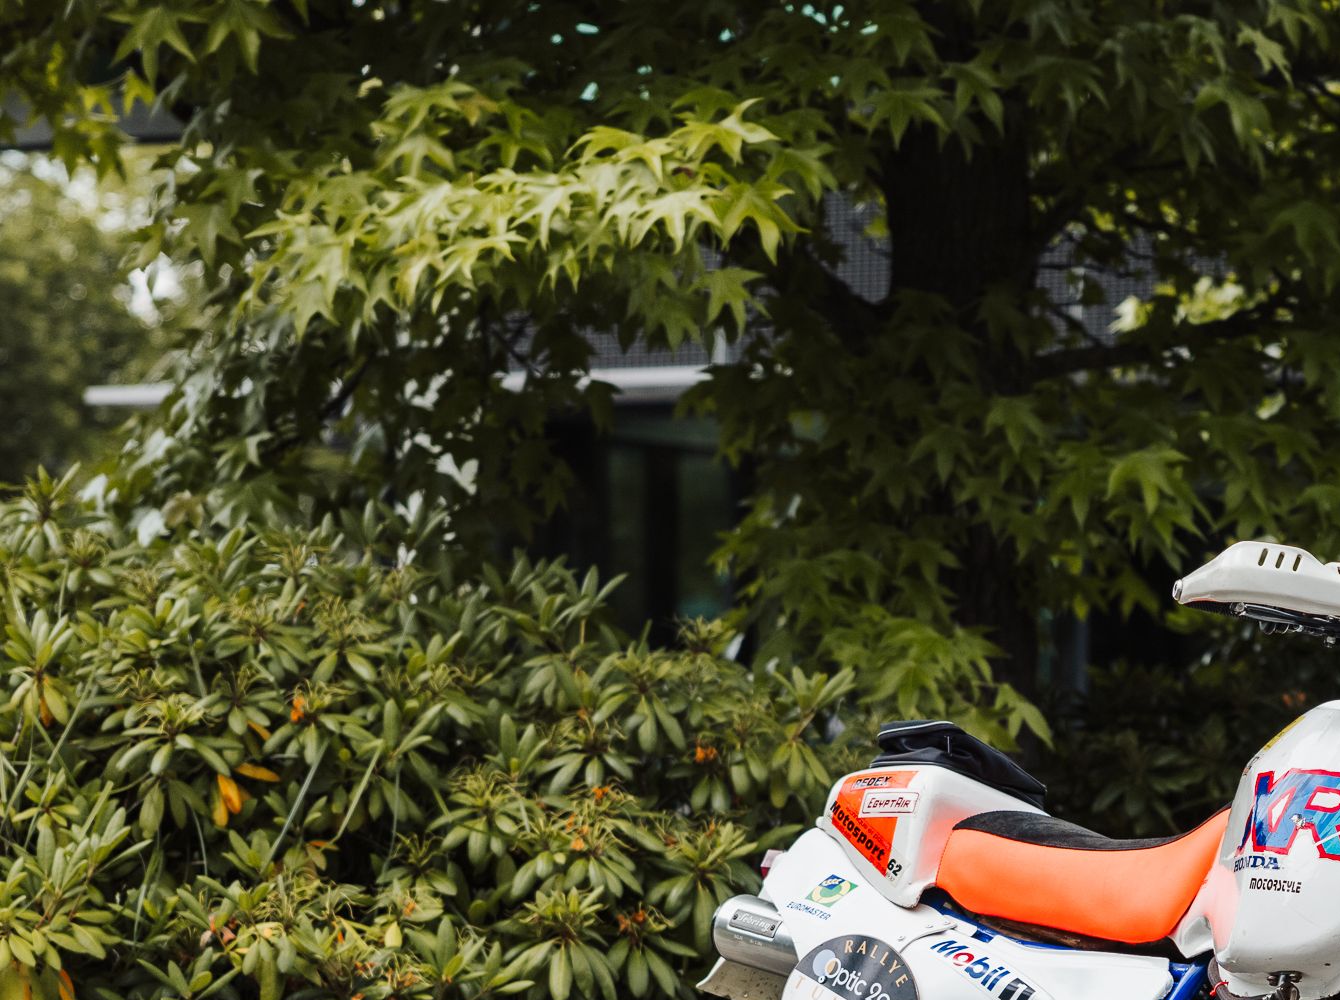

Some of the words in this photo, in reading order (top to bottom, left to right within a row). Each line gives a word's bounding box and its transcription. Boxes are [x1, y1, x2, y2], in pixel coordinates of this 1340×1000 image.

[830, 800, 885, 861] Motosport
[887, 858, 902, 877] 62
[1234, 855, 1280, 873] HONDA
[1250, 878, 1302, 893] MOTORSTYLE
[738, 911, 772, 933] Sebring
[786, 901, 832, 921] EUROMASTER
[844, 939, 909, 988] RALLYE
[930, 940, 1011, 991] Mobil
[824, 957, 868, 996] Optic
